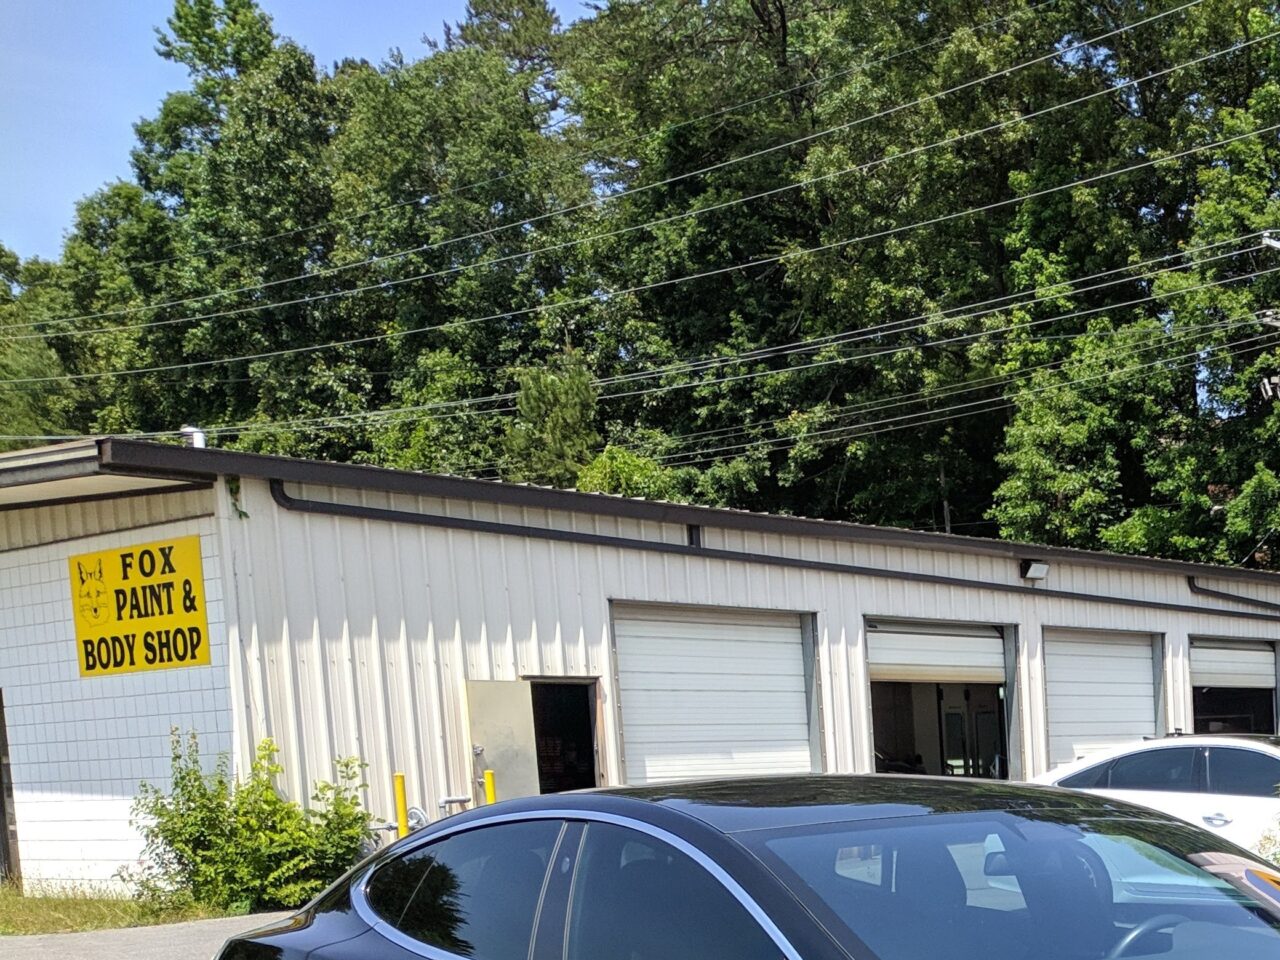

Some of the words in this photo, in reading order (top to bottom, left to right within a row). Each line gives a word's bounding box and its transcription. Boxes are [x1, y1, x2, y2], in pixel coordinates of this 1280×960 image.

[120, 545, 177, 581] FOX
[114, 581, 175, 621] PAINT
[182, 578, 198, 613] &
[82, 633, 137, 671] BODY
[143, 626, 202, 665] SHOP
